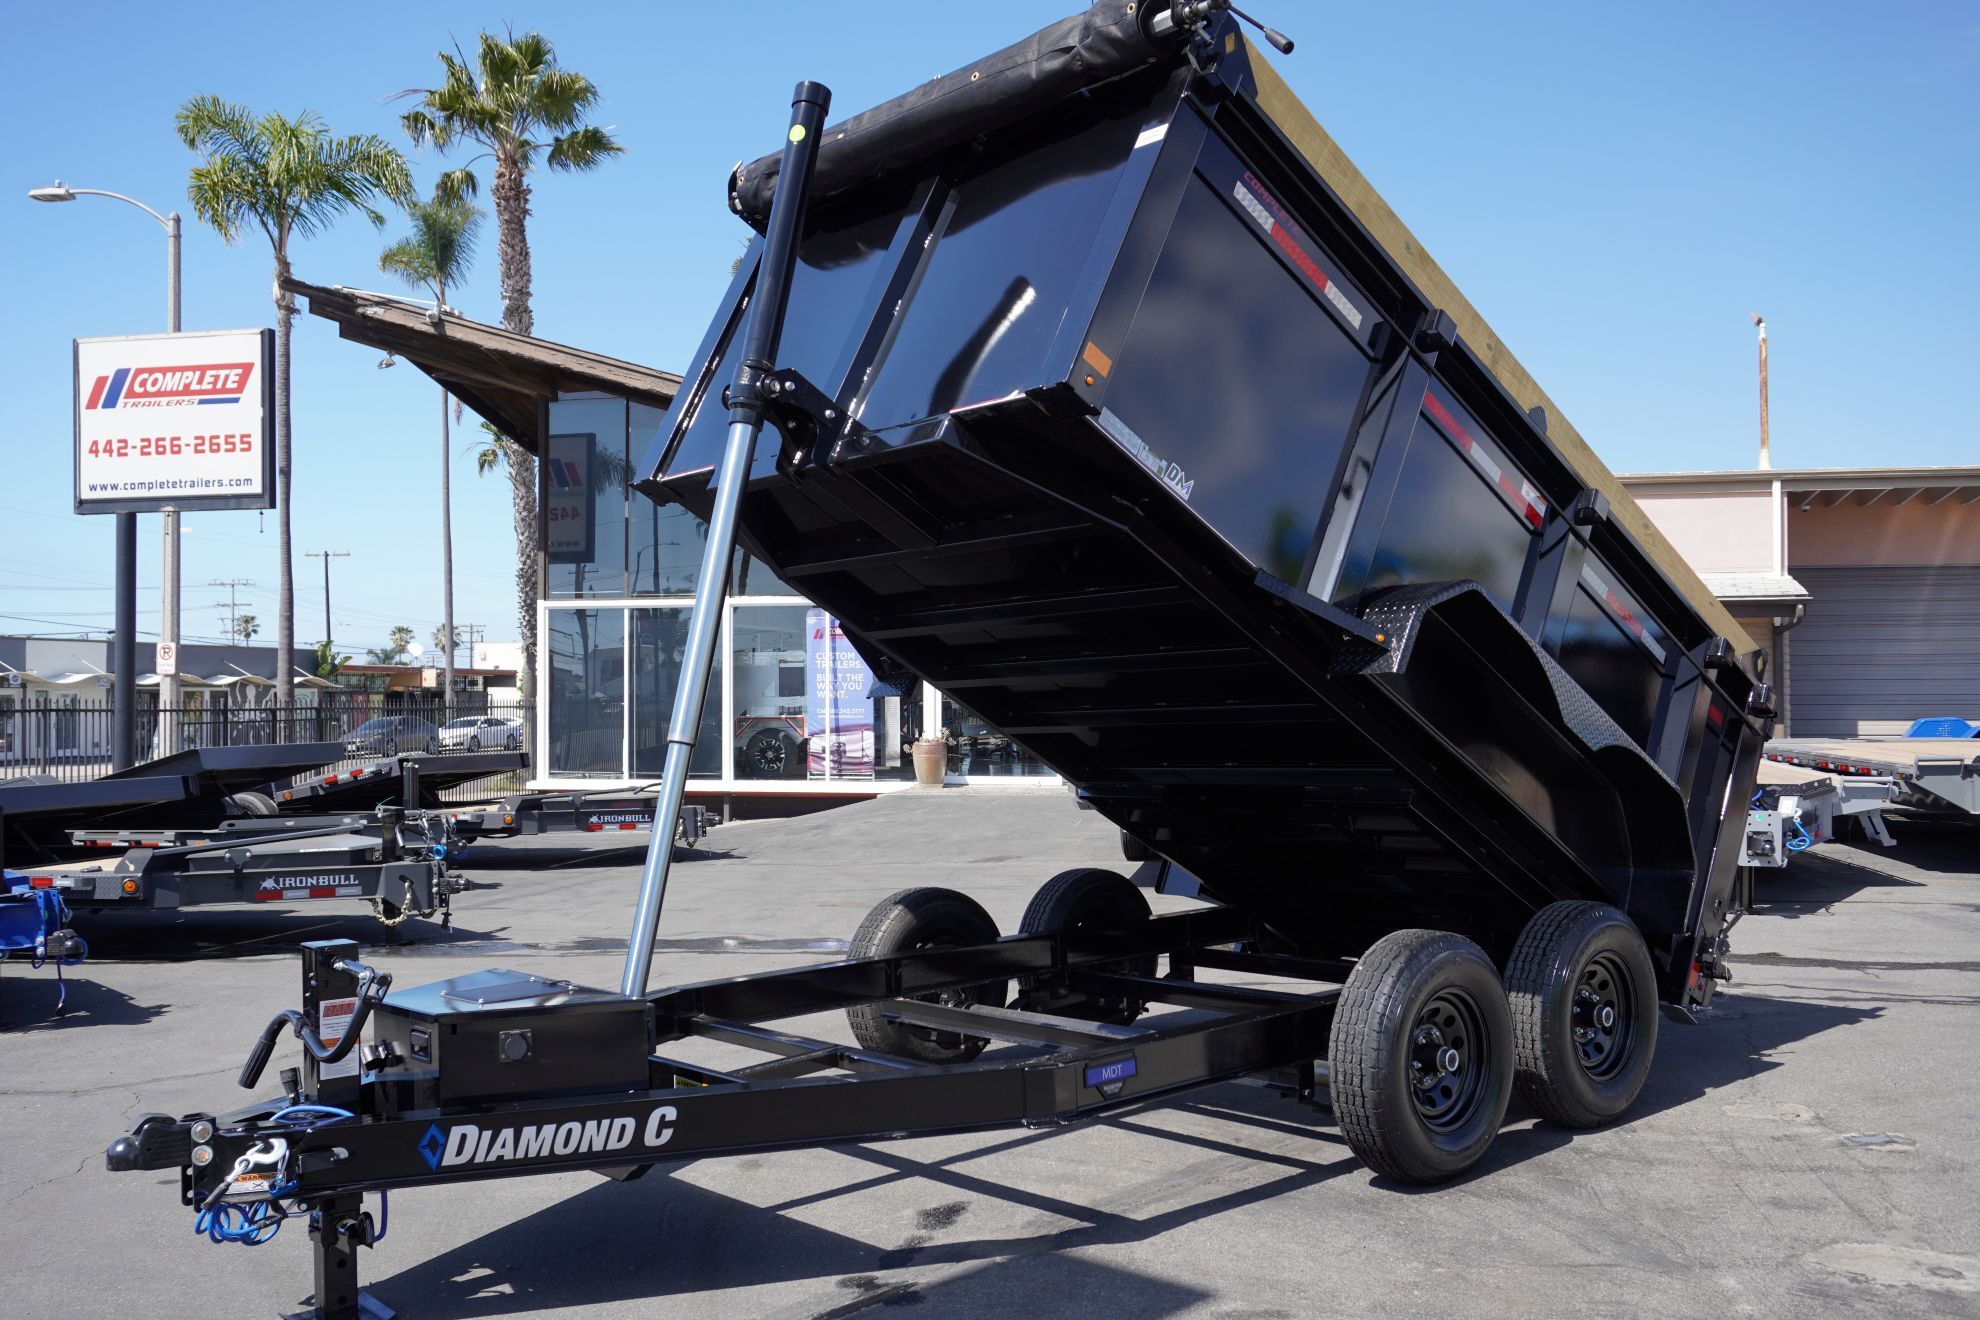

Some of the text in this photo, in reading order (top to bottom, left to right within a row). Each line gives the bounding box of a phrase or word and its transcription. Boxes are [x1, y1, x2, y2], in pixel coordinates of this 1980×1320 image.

[133, 368, 243, 393] COMPLETE
[122, 398, 197, 409] TRAILERS
[88, 433, 252, 458] 442-266-2655
[88, 477, 253, 493] www.completetrailers.com
[816, 652, 855, 660] CUSTOM
[845, 673, 864, 682] THE
[842, 681, 863, 690] YOU
[600, 814, 651, 823] IRONBULL
[279, 874, 359, 888] IRONBULL
[1102, 1064, 1123, 1080] MDT
[441, 1105, 678, 1167] DIAMOND C
